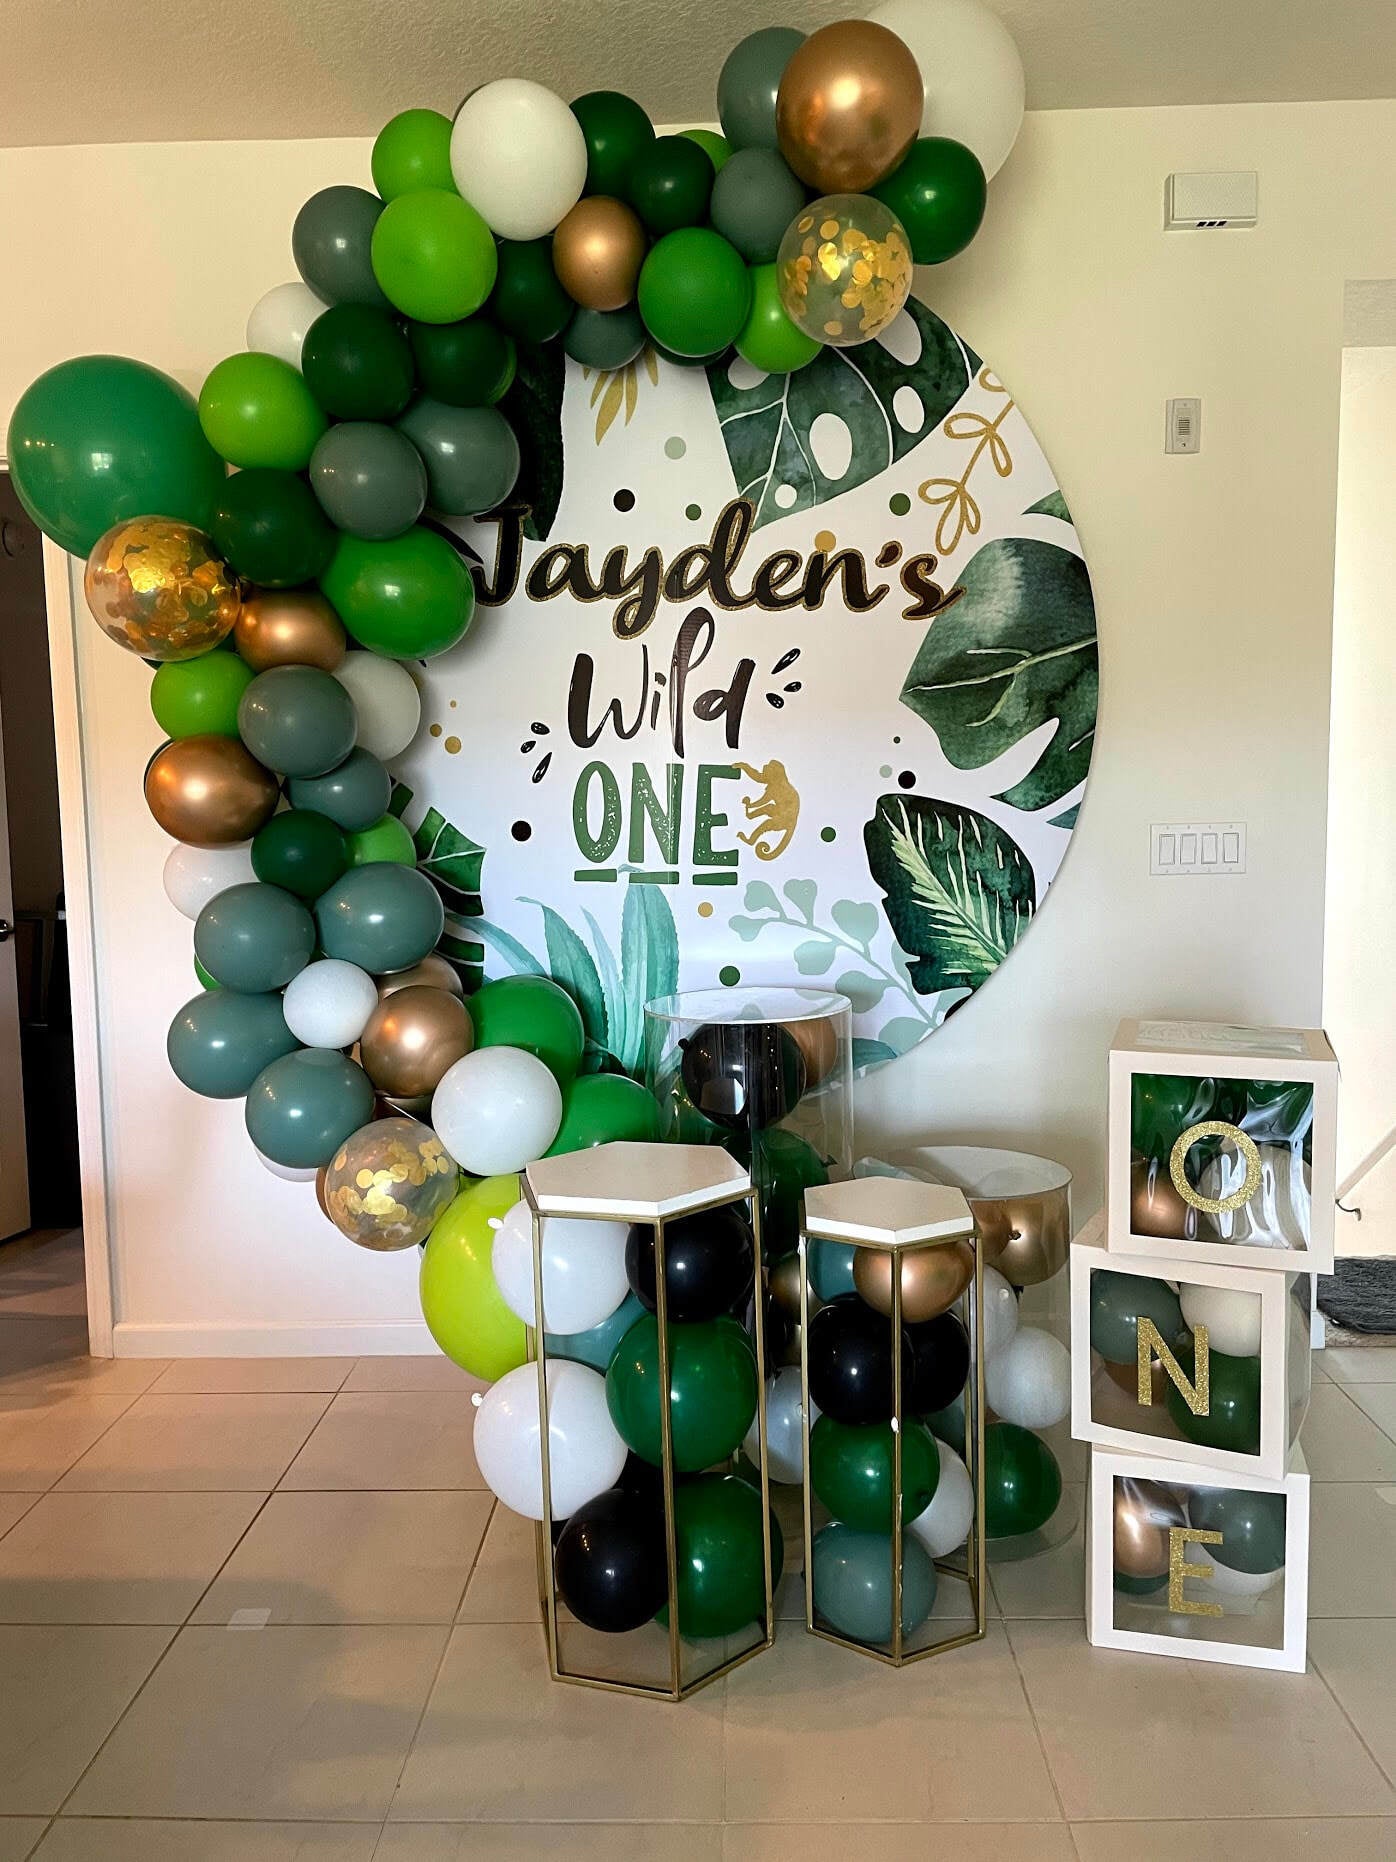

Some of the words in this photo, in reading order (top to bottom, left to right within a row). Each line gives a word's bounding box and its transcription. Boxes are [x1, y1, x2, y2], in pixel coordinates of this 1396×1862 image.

[473, 497, 967, 640] Jayden's
[568, 607, 755, 758] Wild
[572, 760, 741, 864] ONE
